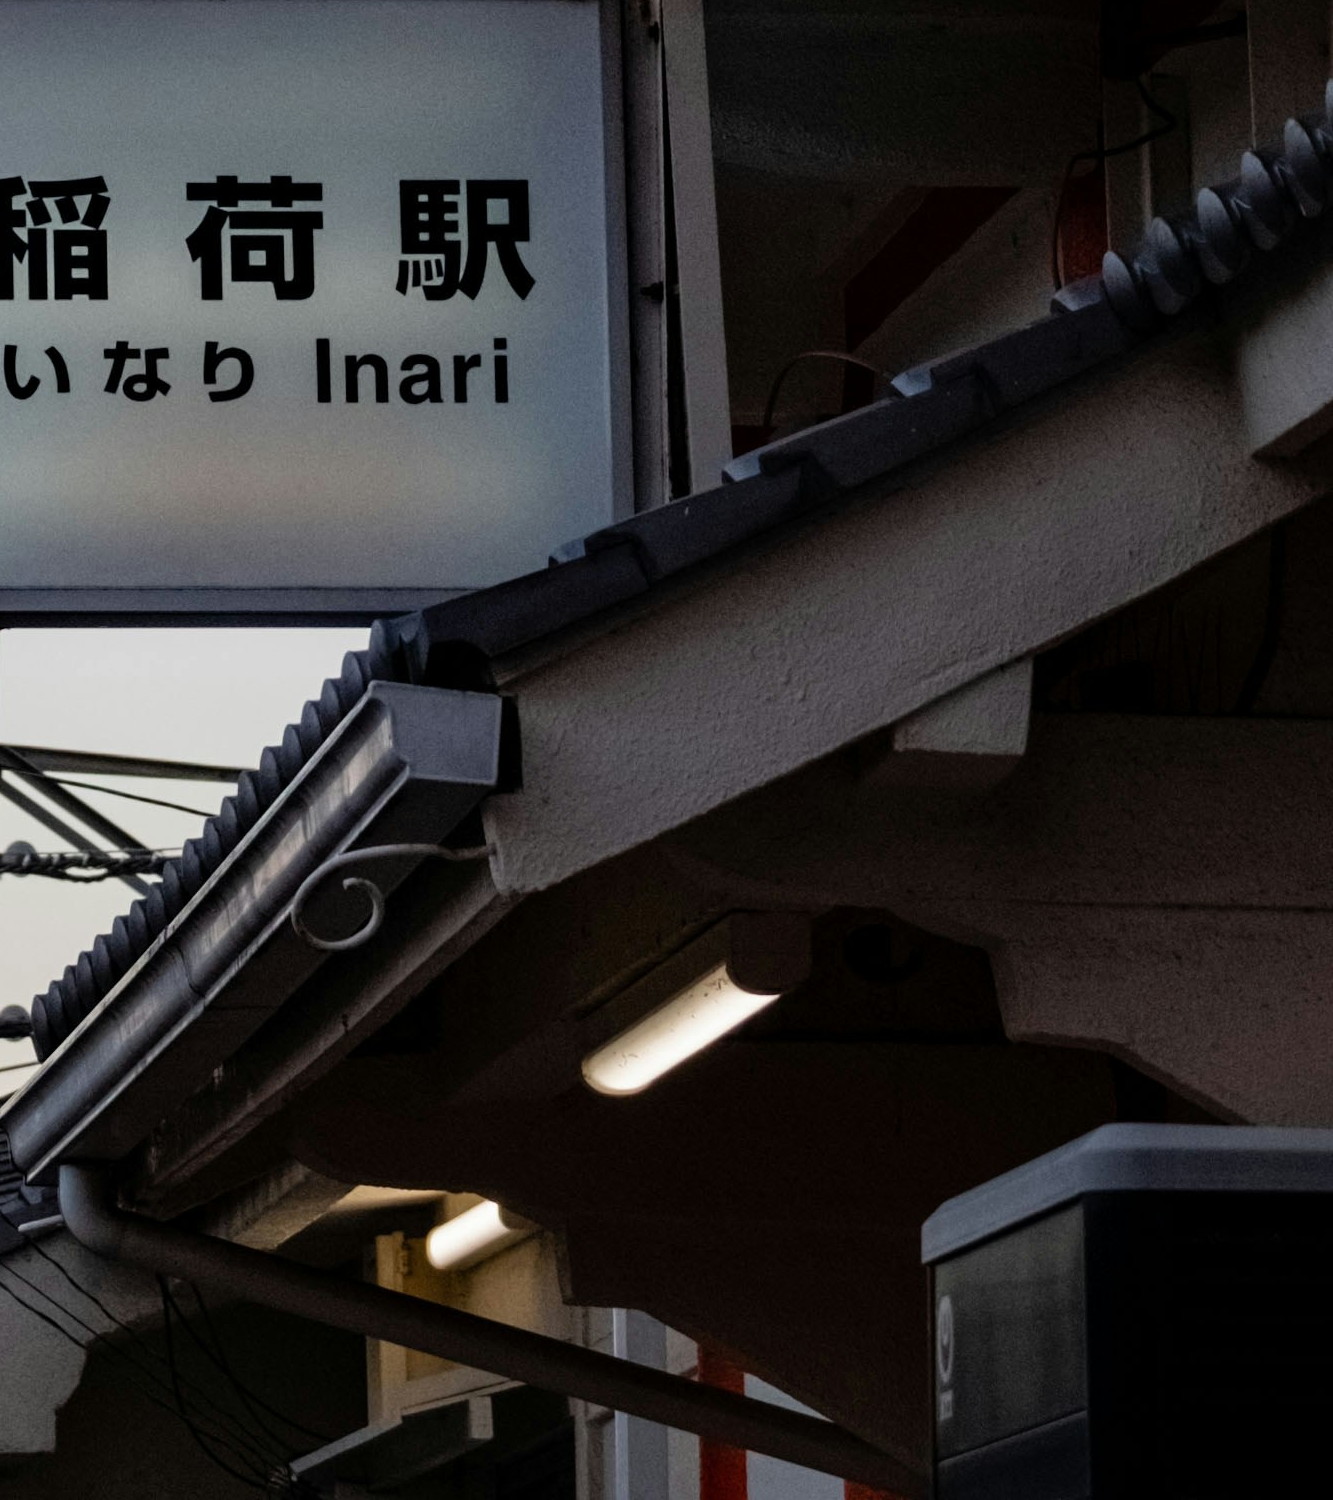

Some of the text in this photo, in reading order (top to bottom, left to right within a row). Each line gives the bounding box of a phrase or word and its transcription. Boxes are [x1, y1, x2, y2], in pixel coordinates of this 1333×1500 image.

[2, 337, 509, 405] いなり Inari
